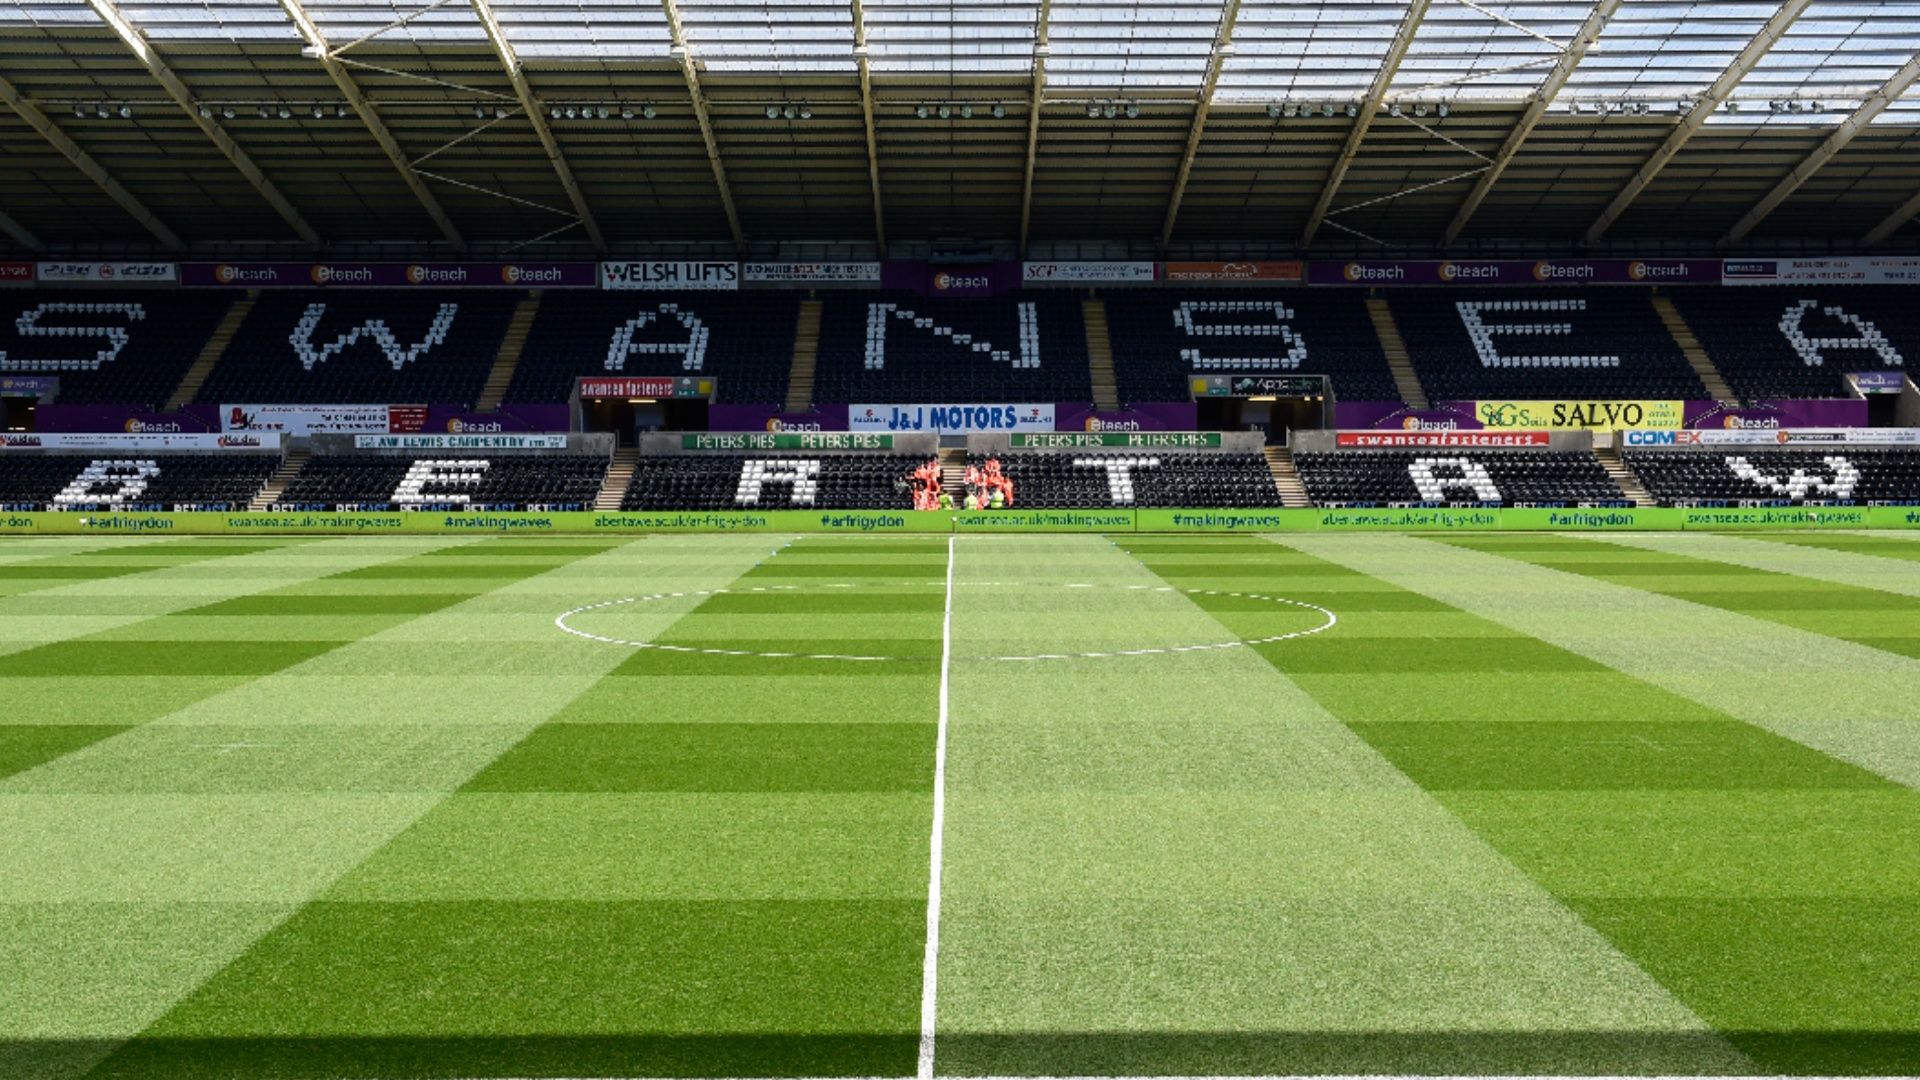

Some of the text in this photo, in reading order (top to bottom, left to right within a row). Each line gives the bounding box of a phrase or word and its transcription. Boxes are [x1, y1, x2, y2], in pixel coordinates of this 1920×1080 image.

[604, 263, 678, 282] WELSH
[686, 263, 737, 282] LIFTS
[888, 406, 1017, 430] J&J MOTORS
[1552, 403, 1643, 427] SALVO
[378, 437, 398, 448] AW
[403, 437, 444, 448] LEWIS
[449, 437, 525, 448] CARPENTRY
[750, 434, 776, 449] PIES
[853, 434, 881, 449] PIES
[1076, 432, 1104, 447] PIES
[1181, 432, 1208, 446] PIES
[1628, 431, 1703, 445] COMEX
[444, 515, 553, 530] #makingwaves
[821, 514, 905, 529] #arfrigydon
[1172, 513, 1280, 528] #makingwaves
[1549, 513, 1634, 528] #arfrigydon
